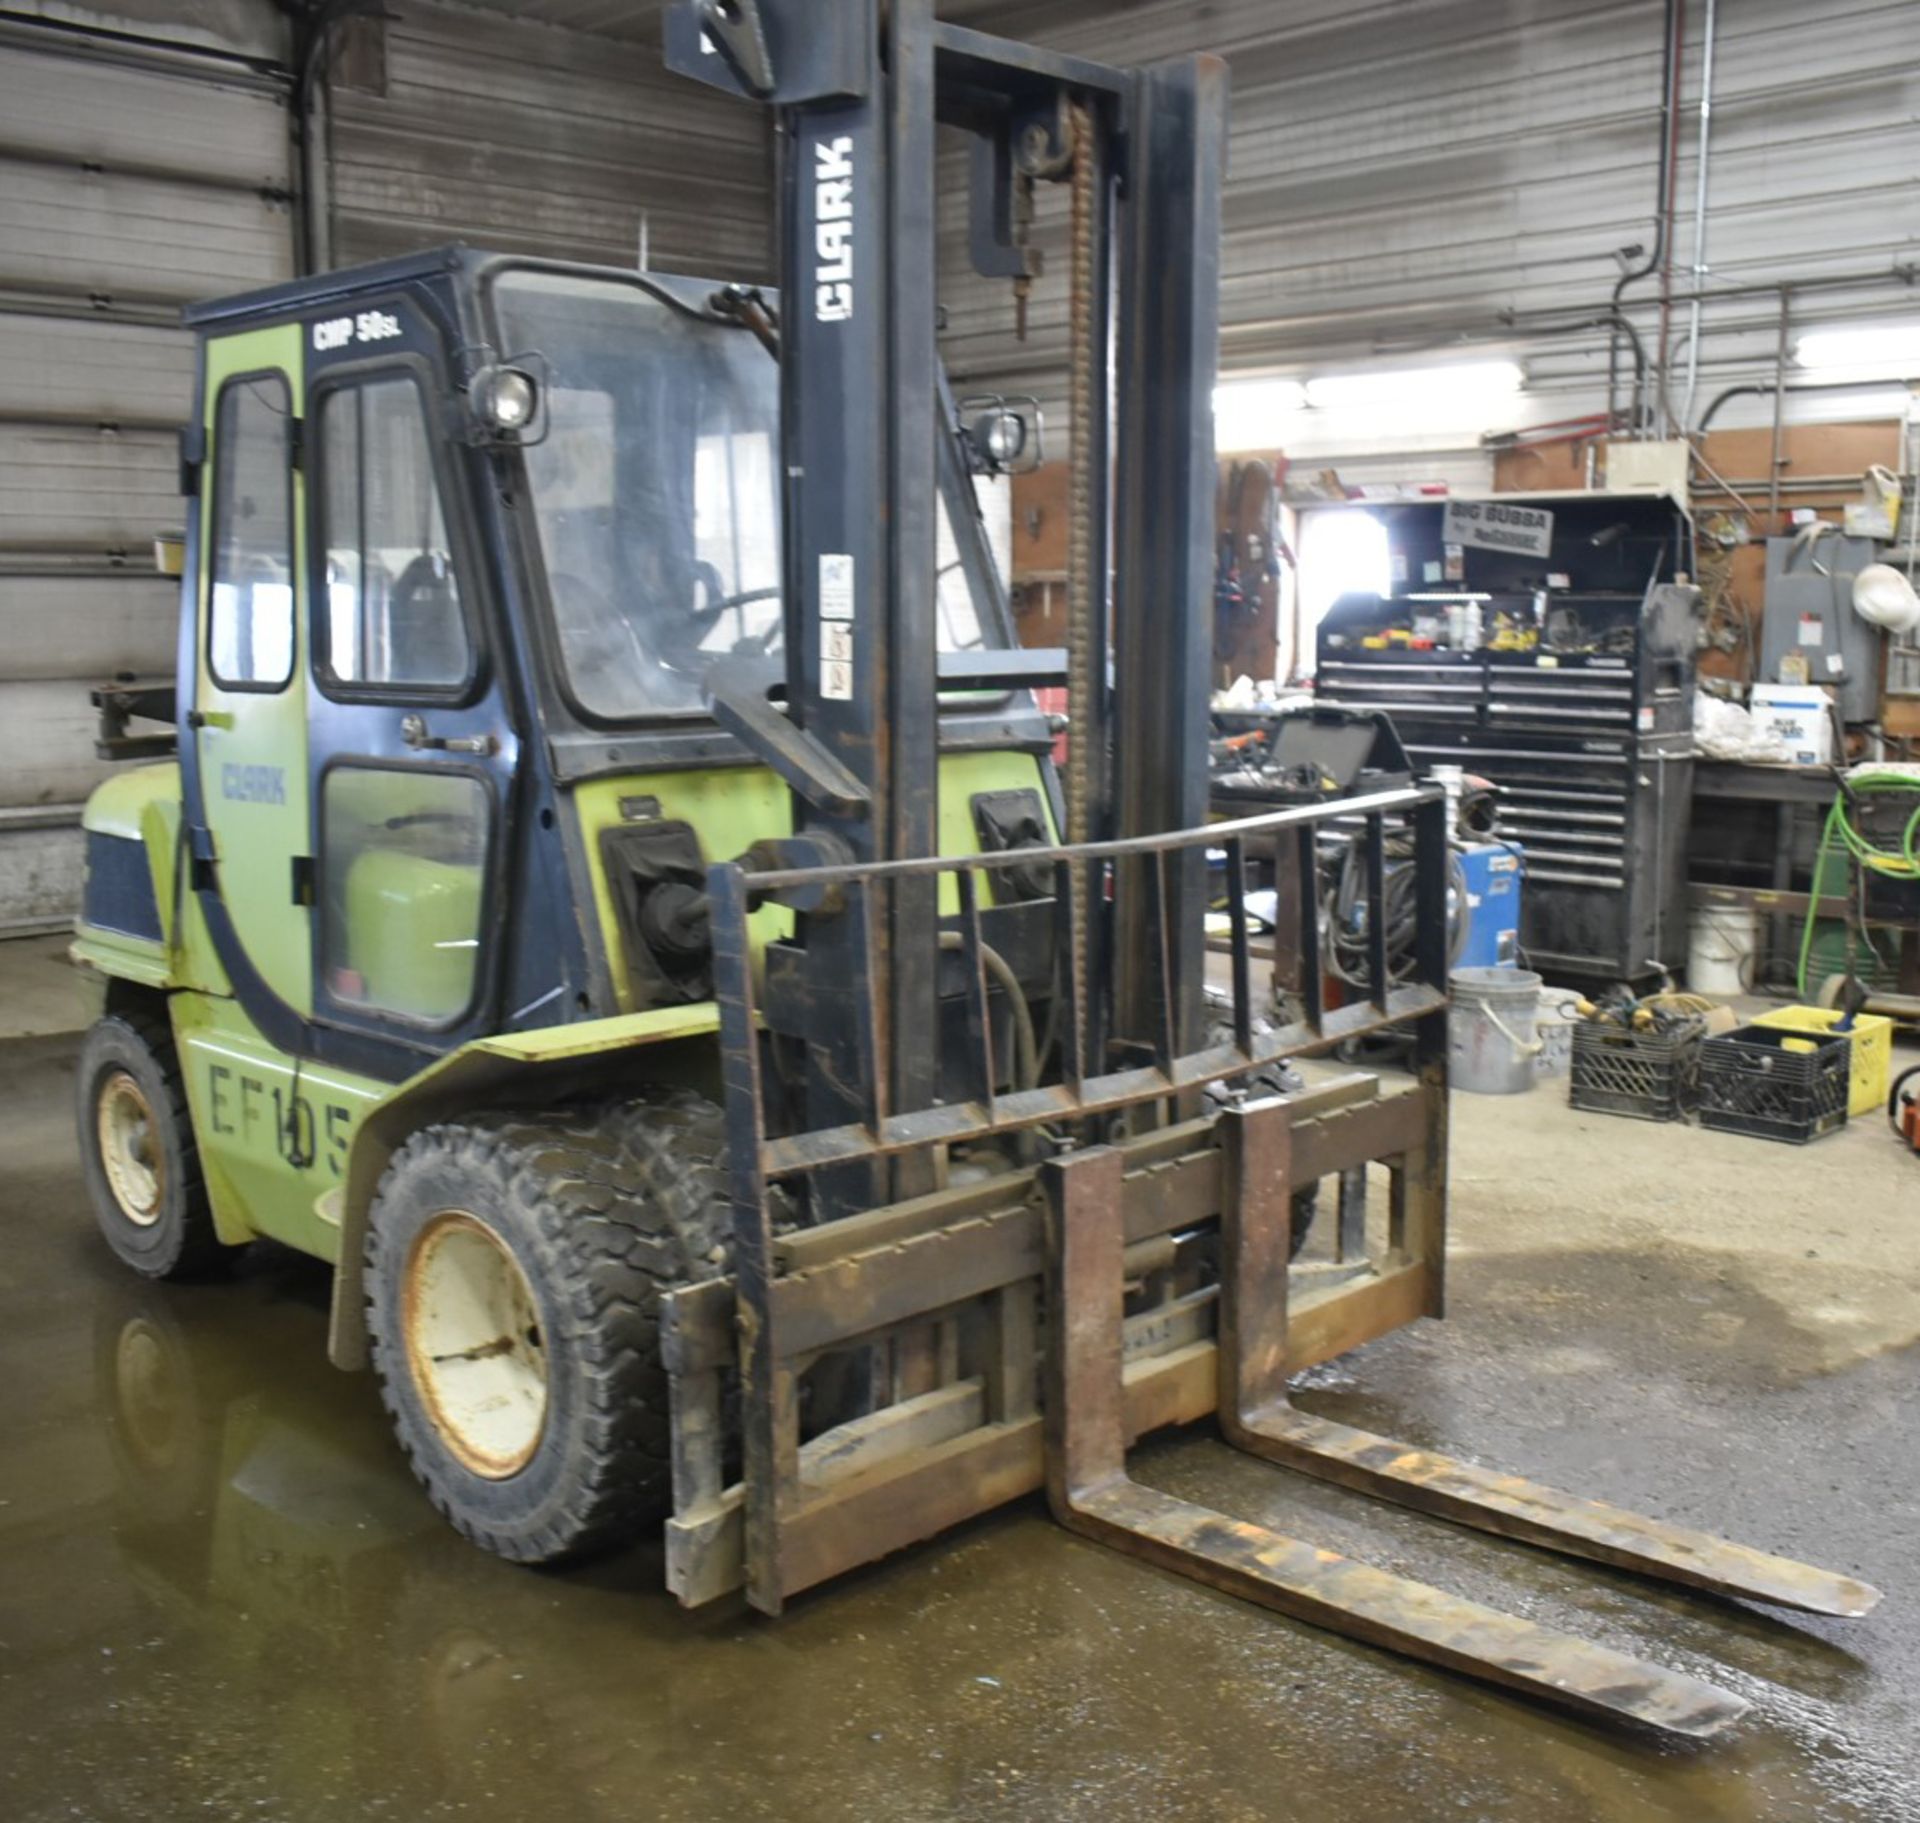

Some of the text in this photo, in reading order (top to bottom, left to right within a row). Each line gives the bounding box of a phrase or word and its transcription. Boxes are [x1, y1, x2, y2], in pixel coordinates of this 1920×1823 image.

[816, 136, 853, 322] CLARK
[1485, 506, 1547, 530] BUBBA
[221, 762, 286, 806] CLARK
